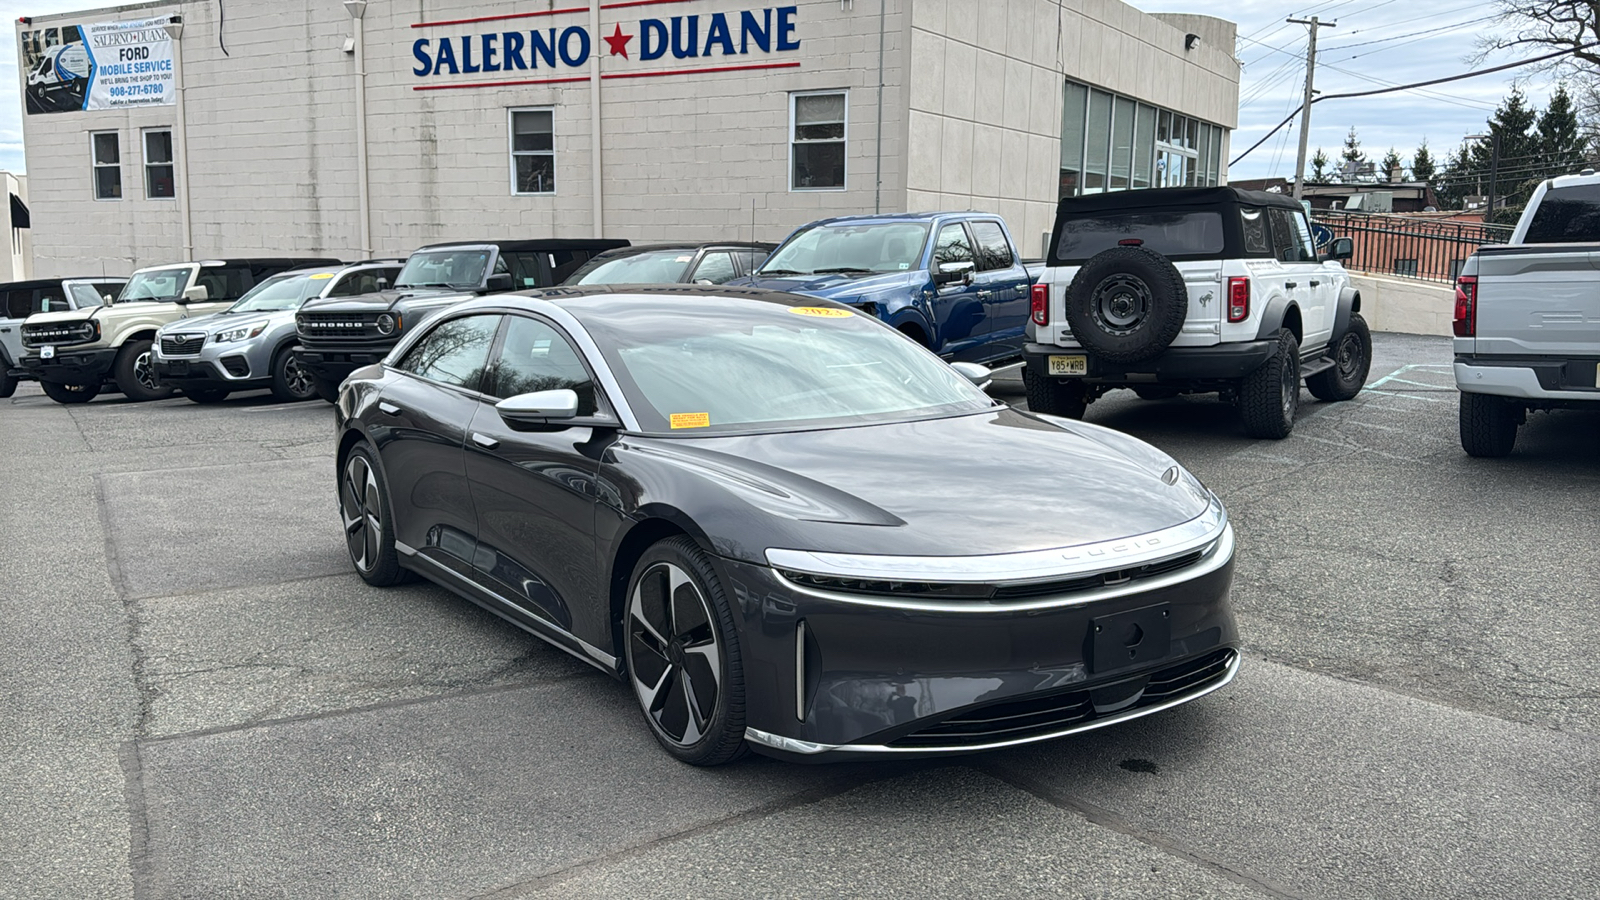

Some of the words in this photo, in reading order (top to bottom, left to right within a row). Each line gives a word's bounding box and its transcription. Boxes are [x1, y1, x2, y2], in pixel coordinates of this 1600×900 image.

[94, 32, 133, 47] SALERNO
[137, 28, 169, 43] DUANE
[412, 25, 591, 77] SALERNO
[639, 6, 801, 61] DUANE
[119, 46, 149, 62] FORD
[100, 63, 133, 76] MOBILE
[134, 59, 172, 74] SERVICE
[114, 76, 129, 84] BRING
[129, 75, 138, 83] THE
[139, 74, 152, 82] SHOP
[109, 83, 164, 97] 908-277-6780
[800, 307, 843, 317] 2023
[30, 329, 69, 337] BRONCO
[1061, 537, 1162, 560] LUCID
